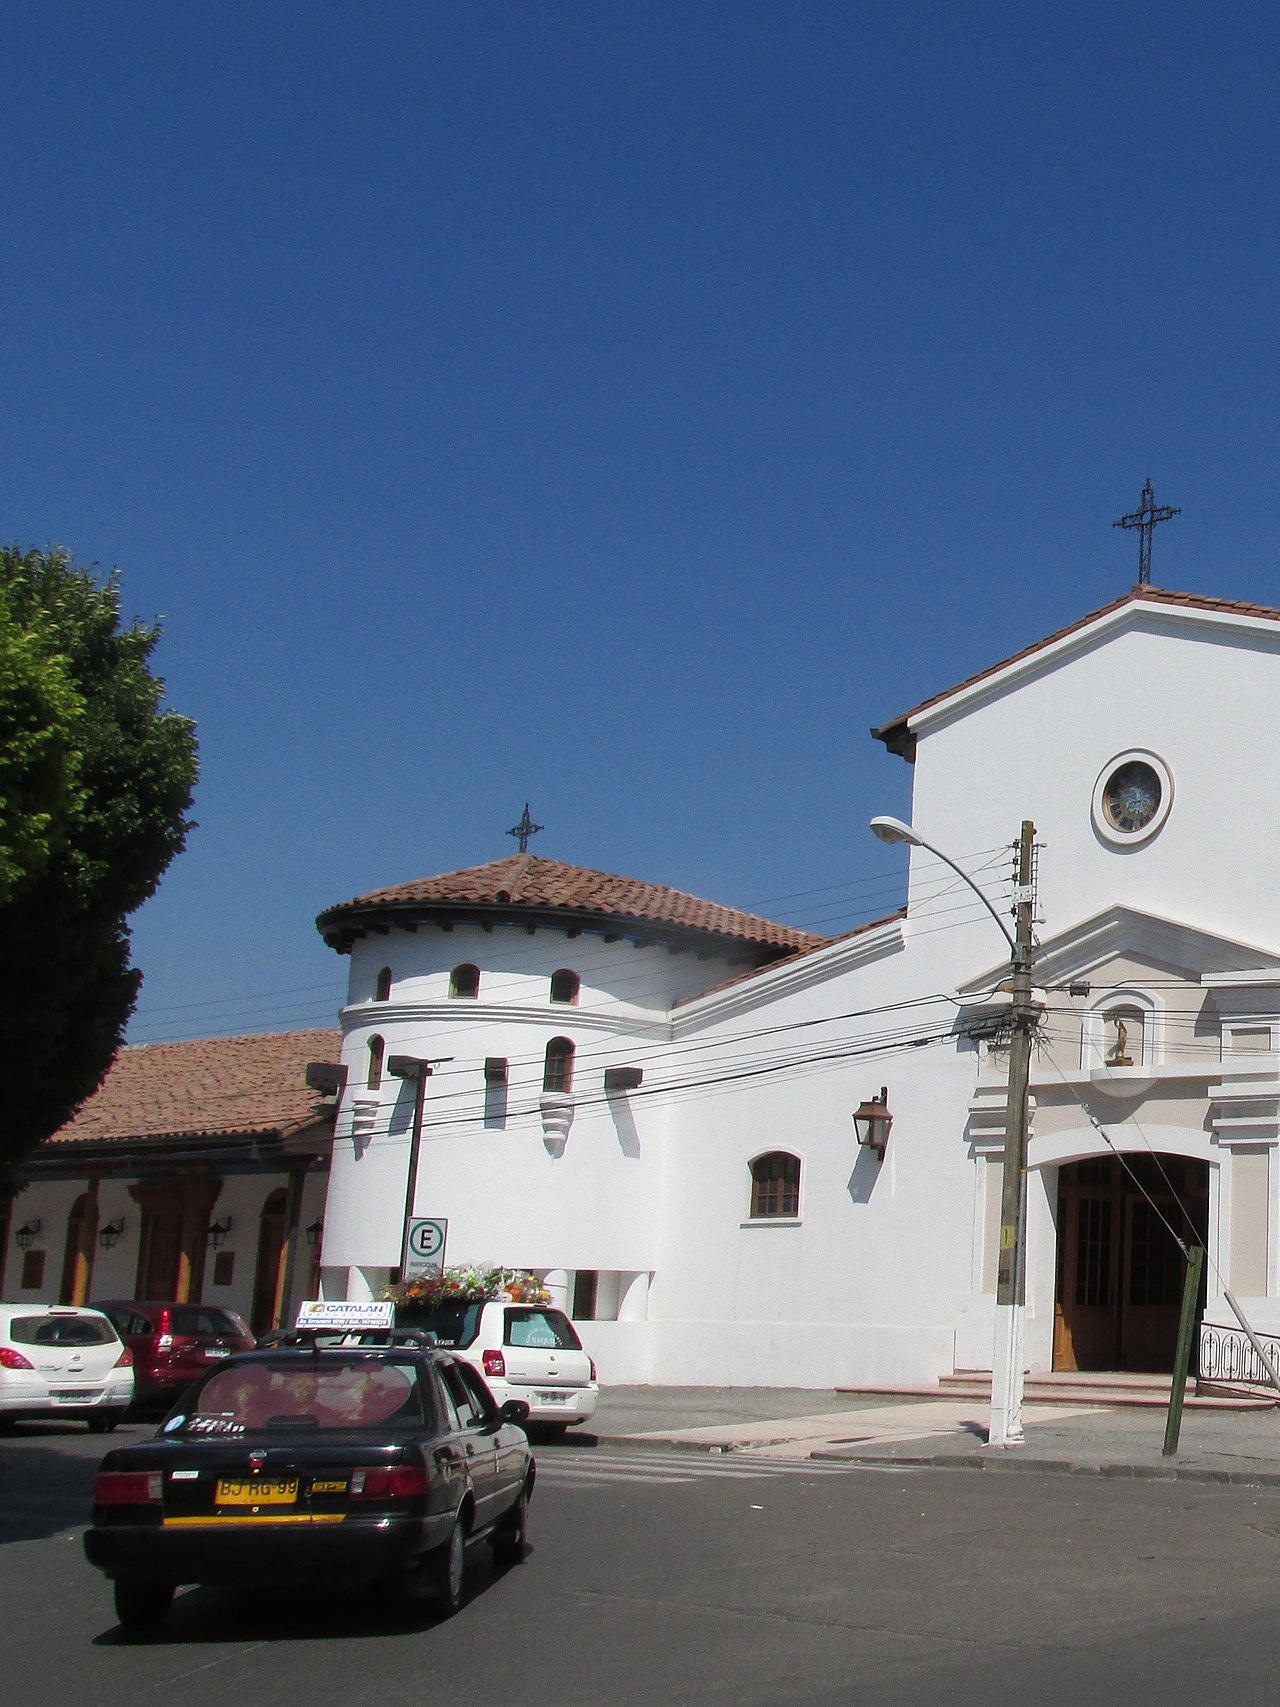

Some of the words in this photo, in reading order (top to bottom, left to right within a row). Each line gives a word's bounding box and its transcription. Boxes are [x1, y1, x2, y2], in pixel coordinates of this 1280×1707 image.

[420, 1229, 434, 1249] E
[326, 1304, 384, 1313] CATALAN
[220, 1481, 243, 1496] BJ
